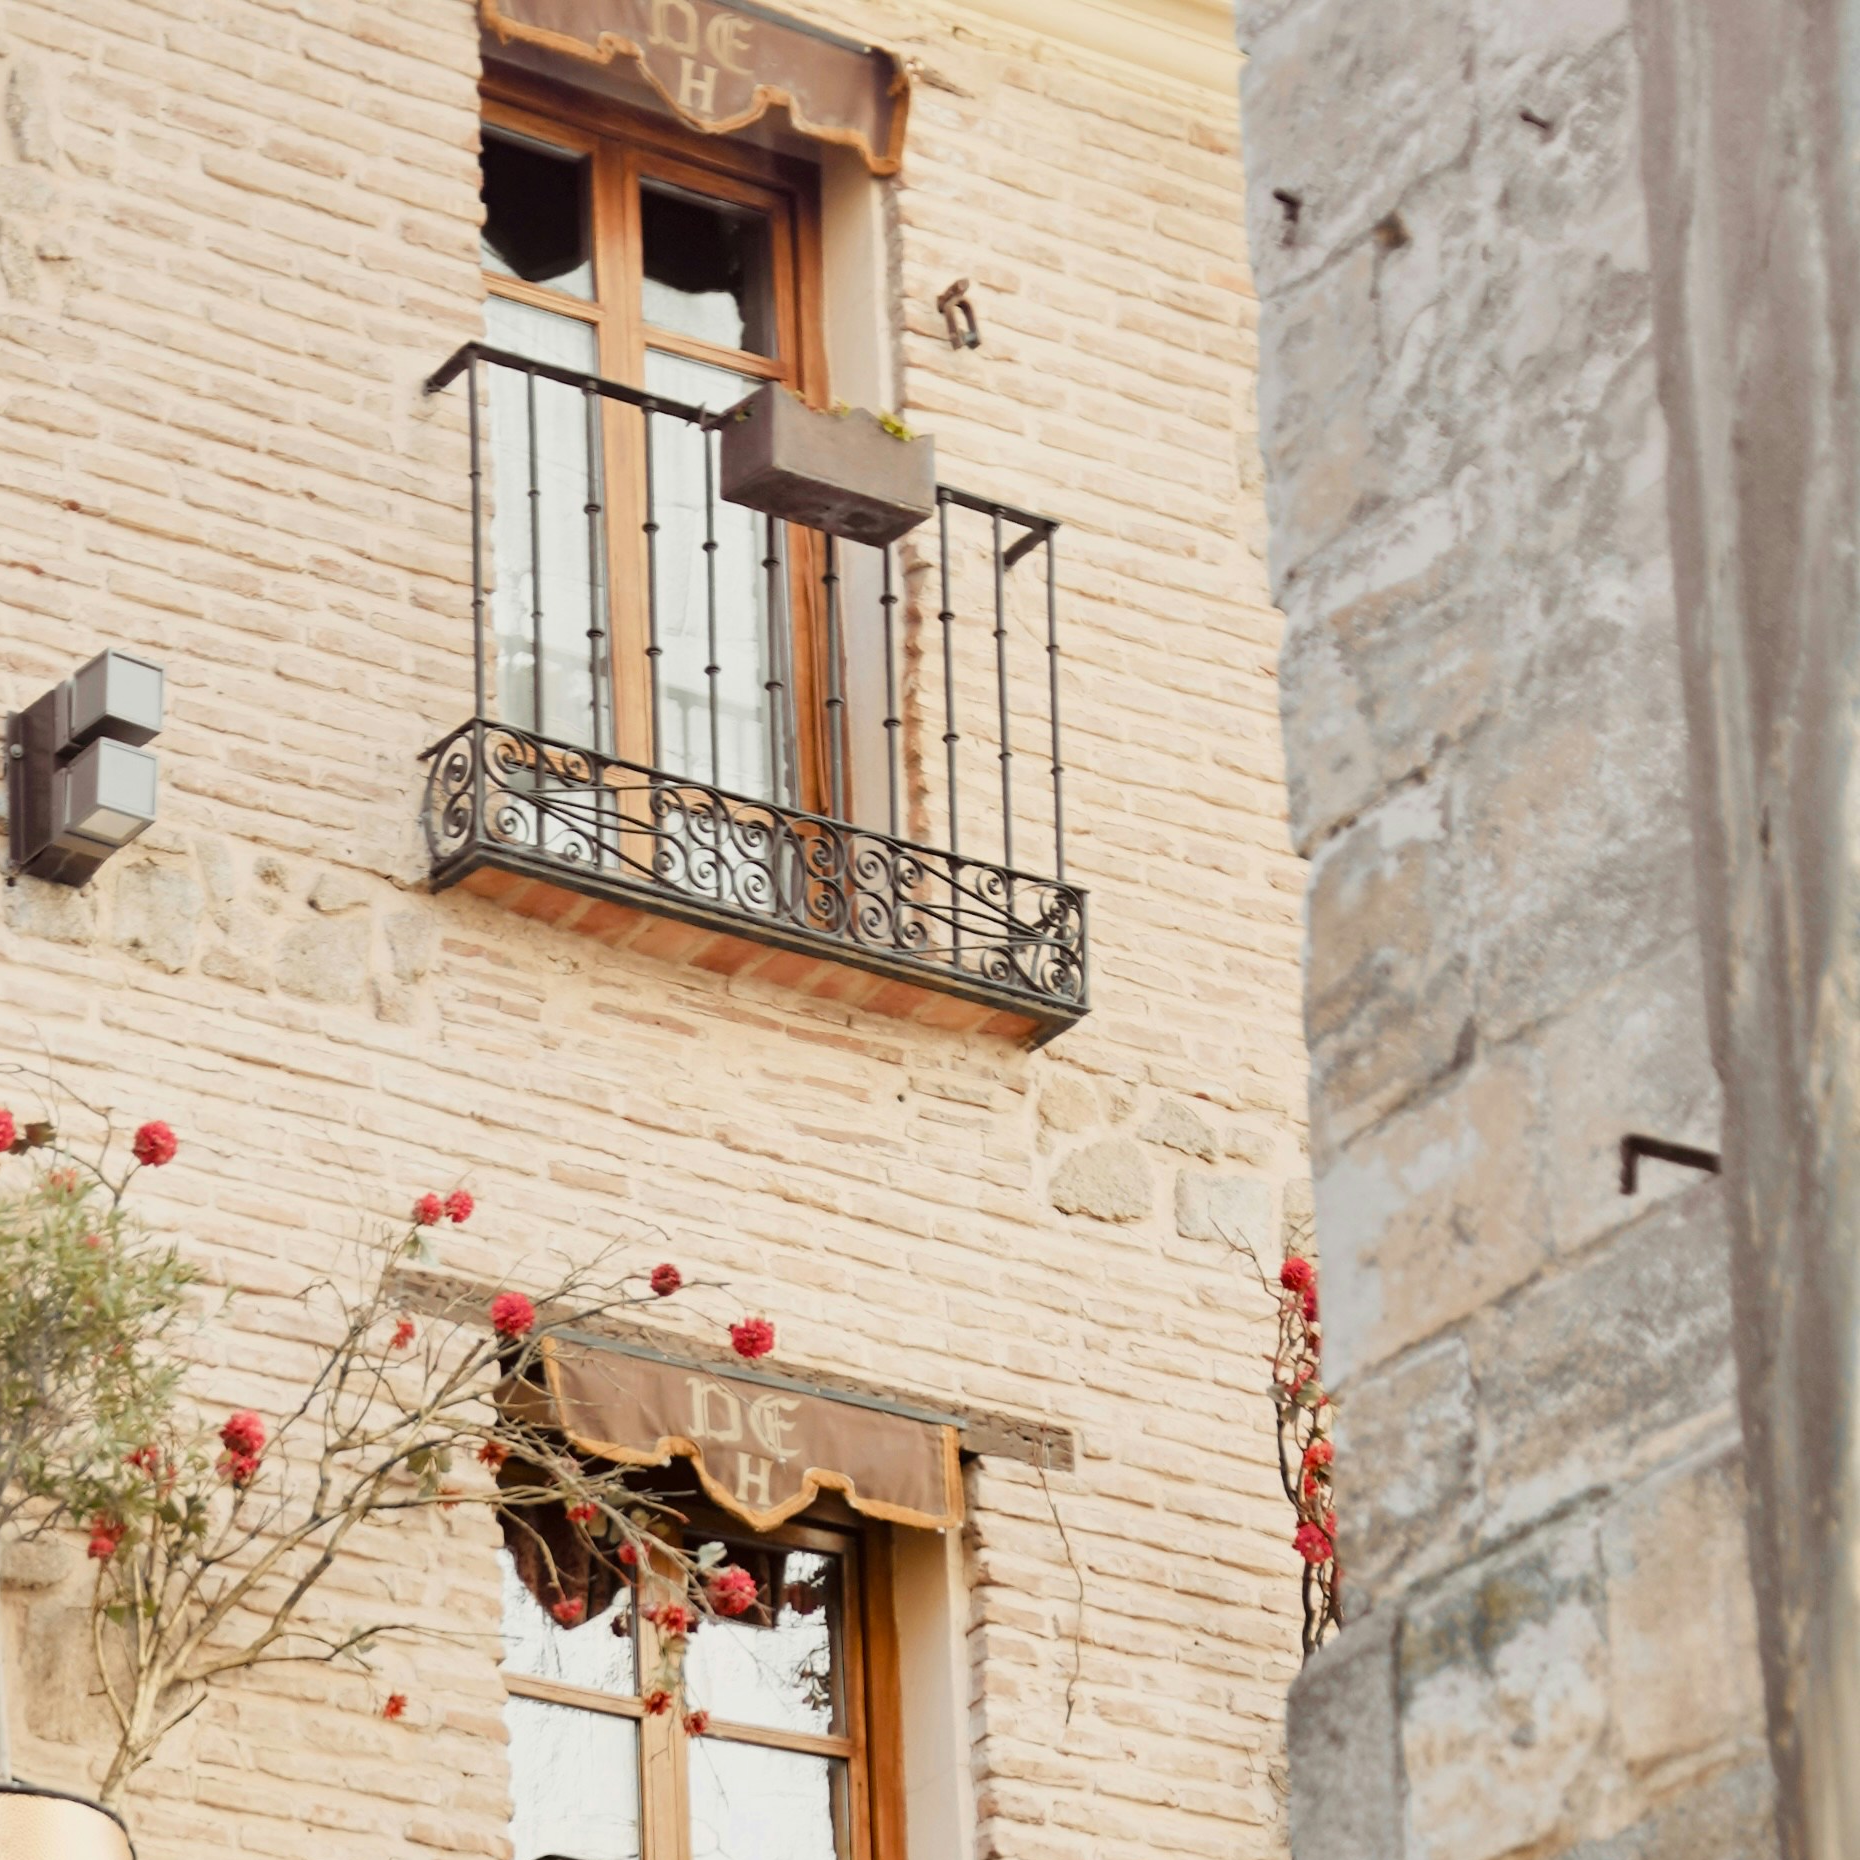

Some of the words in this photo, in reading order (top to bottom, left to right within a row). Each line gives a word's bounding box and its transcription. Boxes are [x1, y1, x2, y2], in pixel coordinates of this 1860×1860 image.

[677, 54, 719, 114] H
[686, 1377, 801, 1458] DE
[735, 1451, 774, 1507] H
